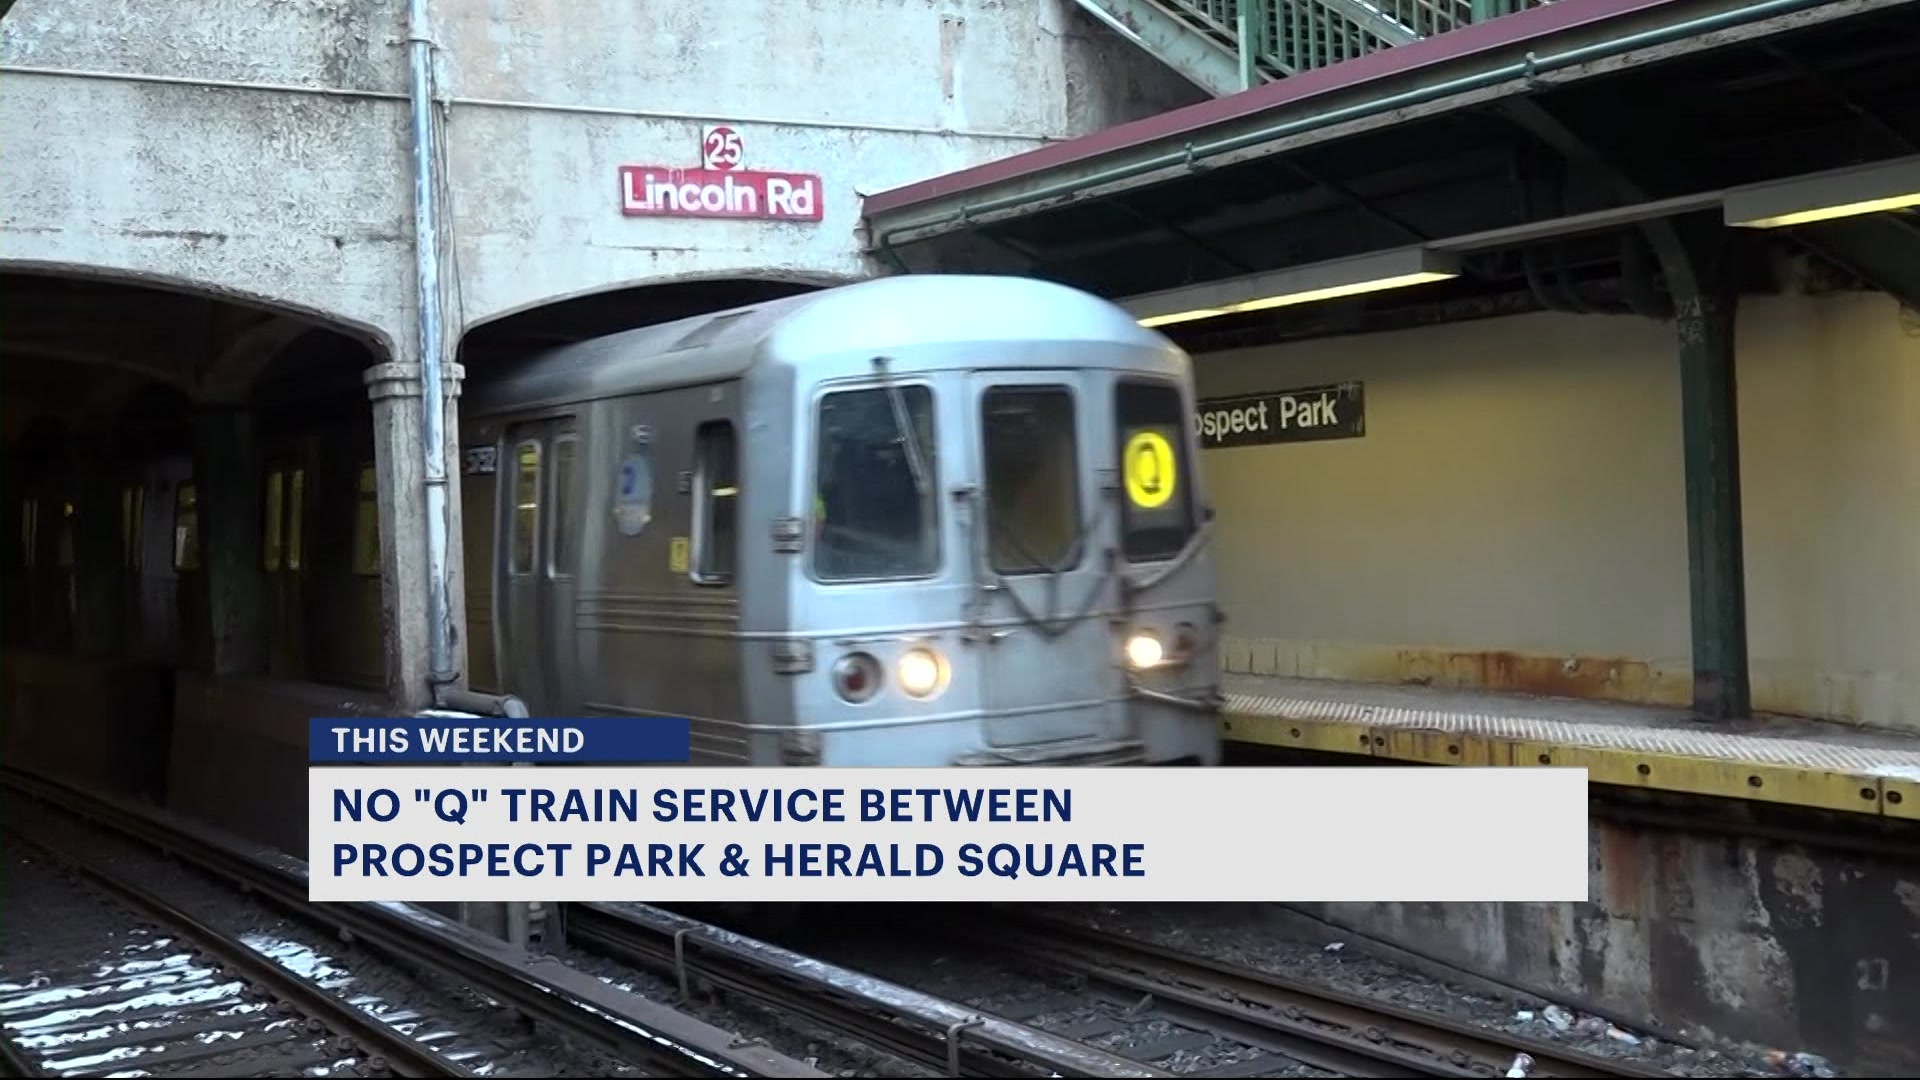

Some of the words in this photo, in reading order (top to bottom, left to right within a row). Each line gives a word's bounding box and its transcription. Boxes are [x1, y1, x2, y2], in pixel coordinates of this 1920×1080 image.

[708, 133, 742, 163] 25
[623, 171, 757, 212] Lincoln
[766, 177, 815, 216] Rd
[1280, 393, 1338, 430] Park
